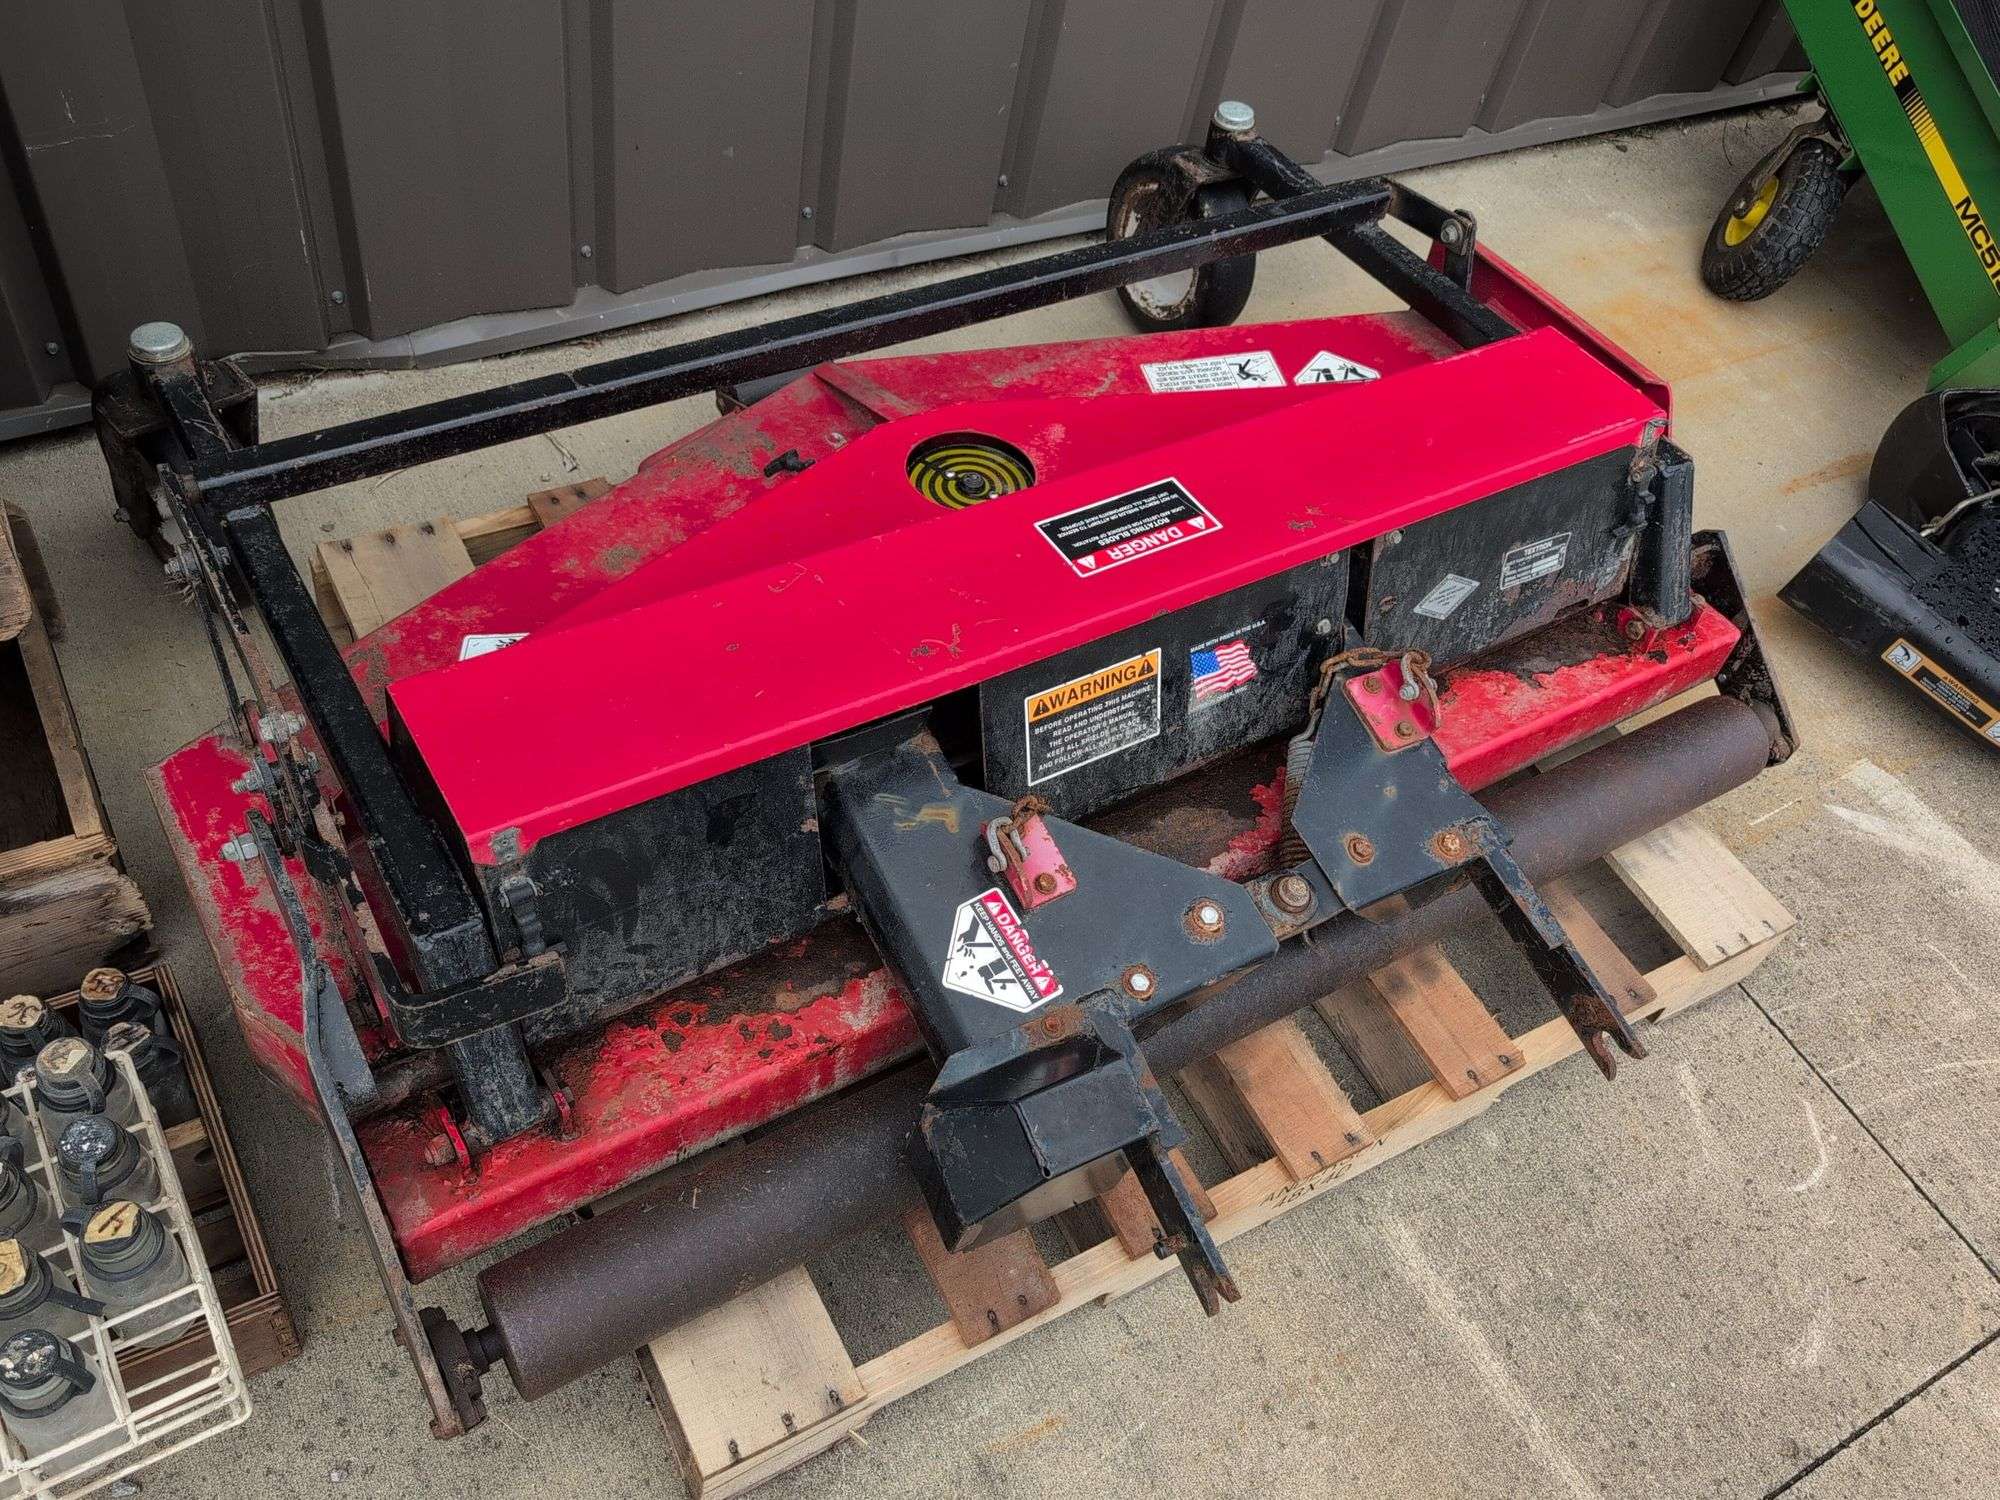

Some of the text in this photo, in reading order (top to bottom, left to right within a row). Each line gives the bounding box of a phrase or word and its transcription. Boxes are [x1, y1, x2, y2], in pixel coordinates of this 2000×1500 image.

[1855, 0, 1909, 87] DEERE
[1955, 196, 2000, 292] MC51
[1096, 516, 1171, 546] ROTATING BLADES
[1140, 514, 1160, 523] LISTEN
[1104, 525, 1185, 560] DANGER
[1049, 664, 1136, 710] WARNING
[1947, 679, 1979, 703] WARNING
[1034, 718, 1062, 735] BEFORE
[1064, 702, 1102, 723] OPERATING
[1104, 696, 1119, 708] THIS
[1052, 699, 1134, 737] READ AND UNDERSTAND
[1046, 746, 1064, 759] KEEP
[1066, 740, 1079, 751] ALL
[1049, 737, 1062, 748] THE
[1064, 720, 1105, 742] OPERATOR'S
[1038, 760, 1052, 771] AND
[1054, 748, 1082, 765] FOLLOW
[973, 902, 1038, 999] KEEP HANDS and FEET AWAY
[996, 912, 1041, 975] DANGER
